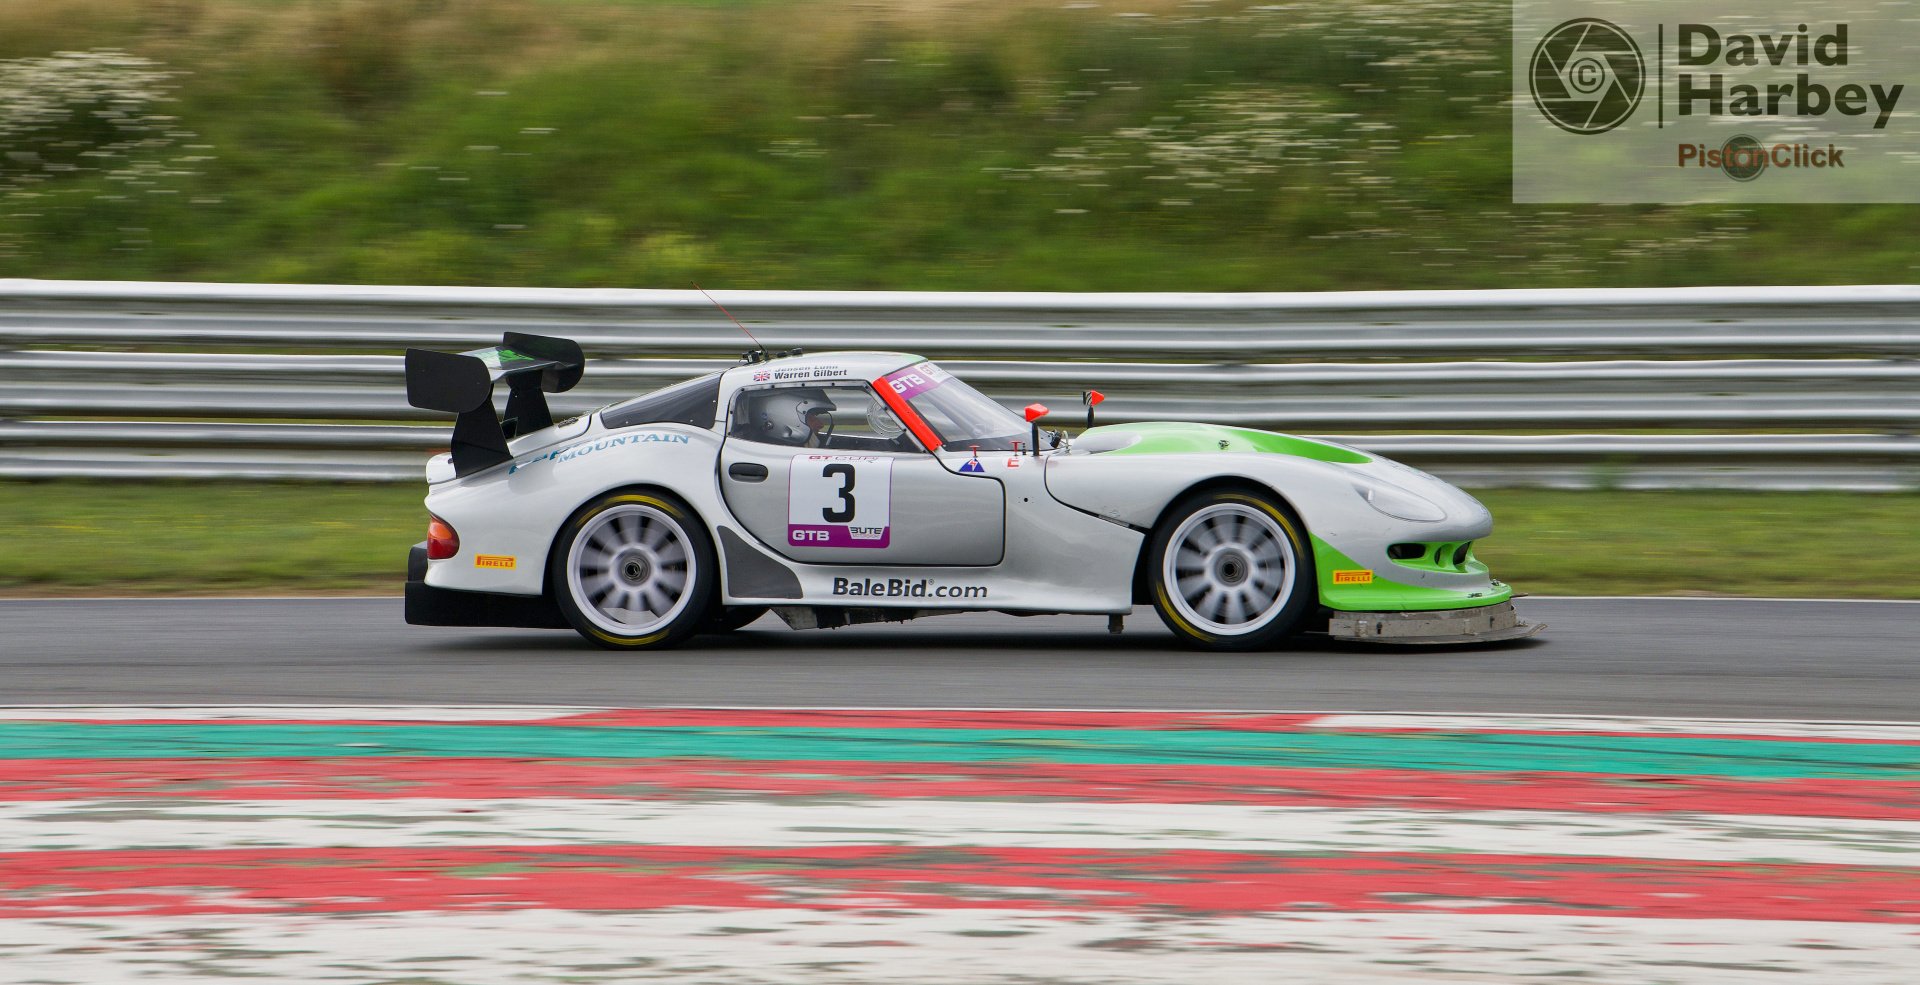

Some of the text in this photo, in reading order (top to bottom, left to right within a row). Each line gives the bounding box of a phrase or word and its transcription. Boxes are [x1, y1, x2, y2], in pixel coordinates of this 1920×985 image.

[774, 369, 848, 379] Warren Gilbert
[889, 373, 926, 394] GTB
[557, 433, 690, 463] MOUNTAIN
[822, 463, 856, 523] 3
[792, 529, 830, 541] GTB
[476, 555, 514, 568] PIRELLI
[1335, 571, 1371, 582] PIRELLI
